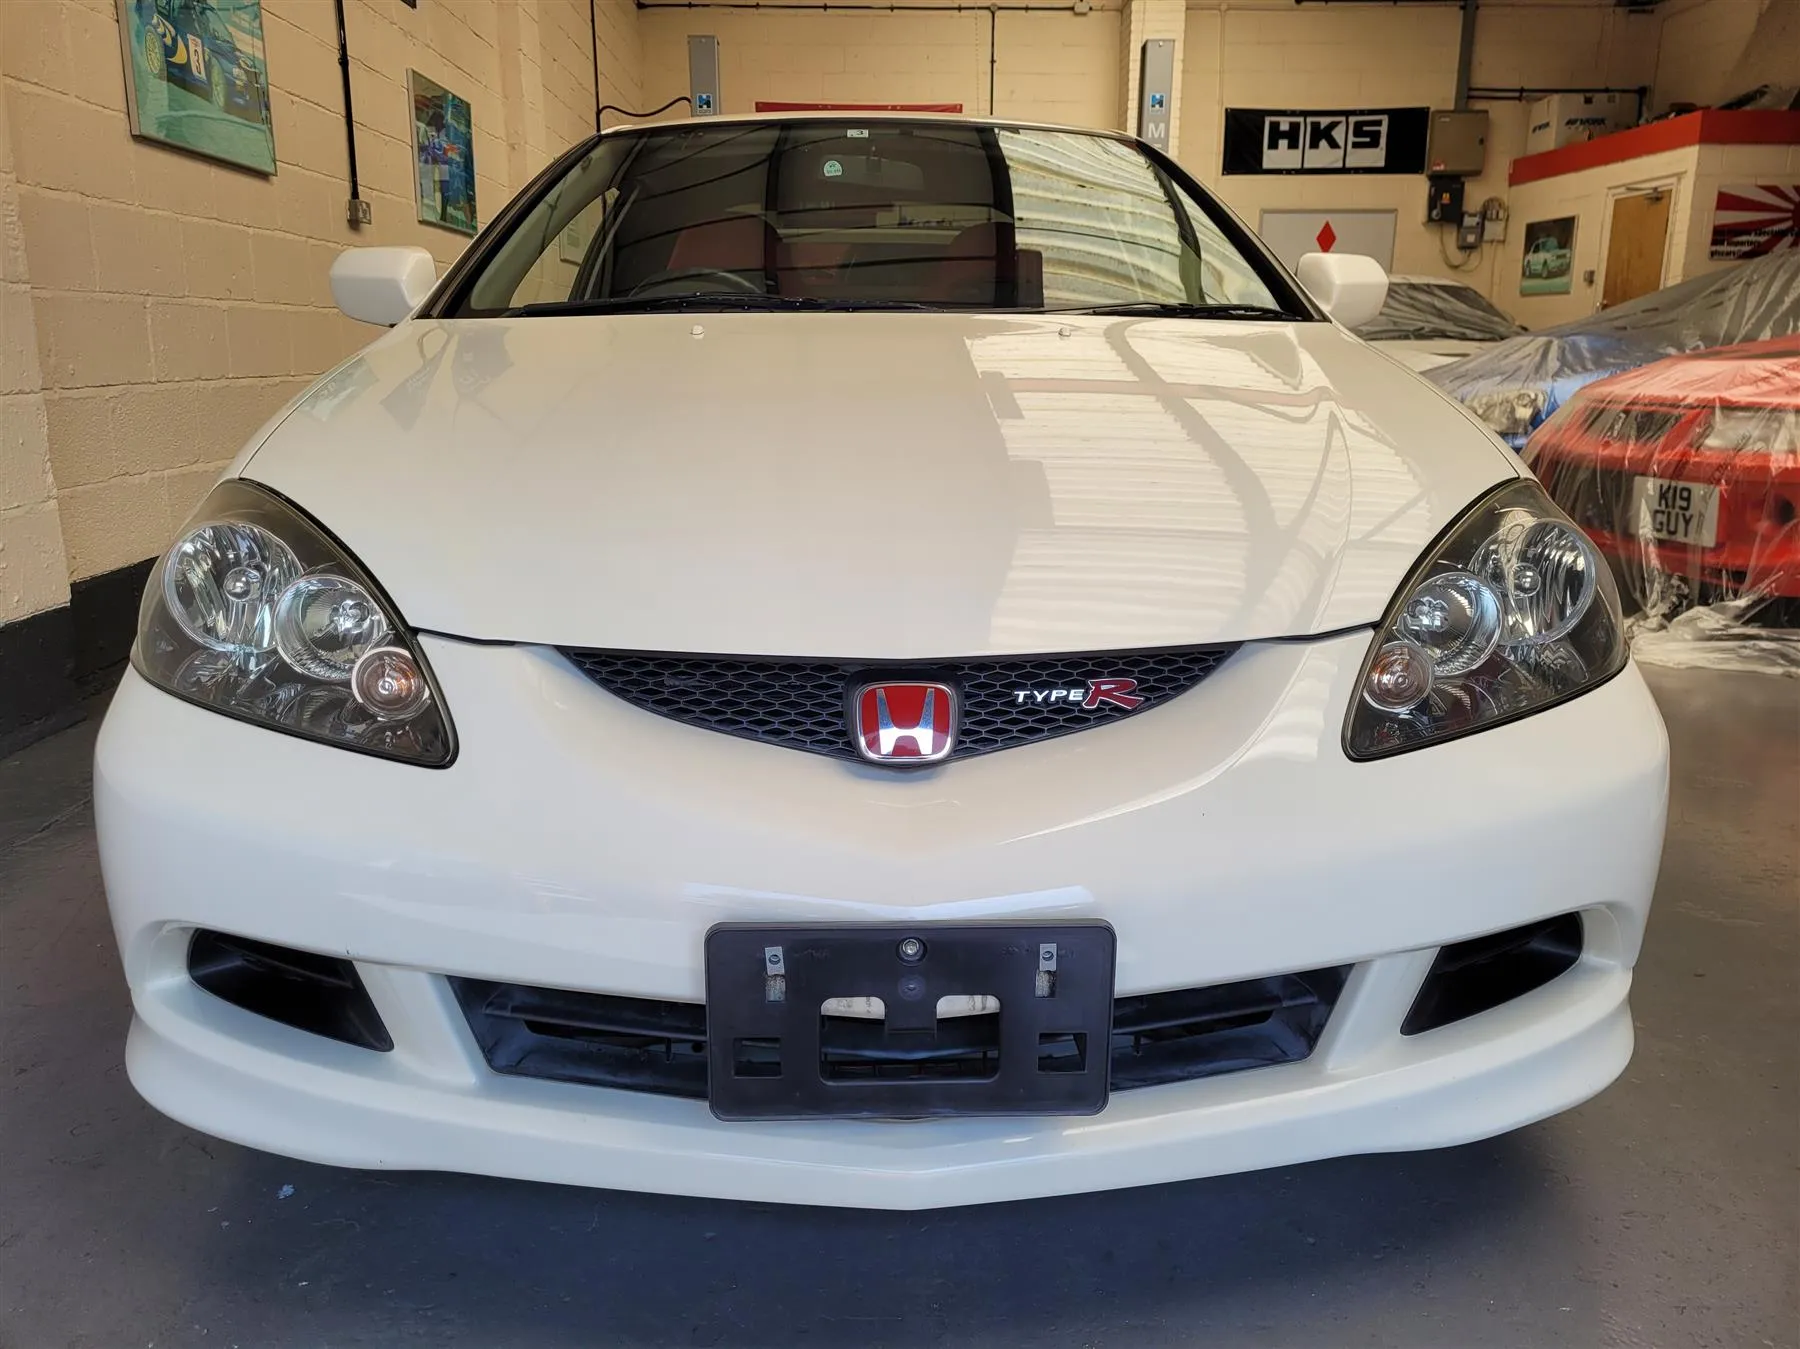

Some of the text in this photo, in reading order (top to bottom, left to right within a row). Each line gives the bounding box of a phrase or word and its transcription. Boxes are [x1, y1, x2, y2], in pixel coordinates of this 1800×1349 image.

[1266, 119, 1384, 150] HKS
[1658, 483, 1692, 512] K19
[1652, 509, 1694, 538] GUY
[1013, 677, 1145, 710] TYPE R
